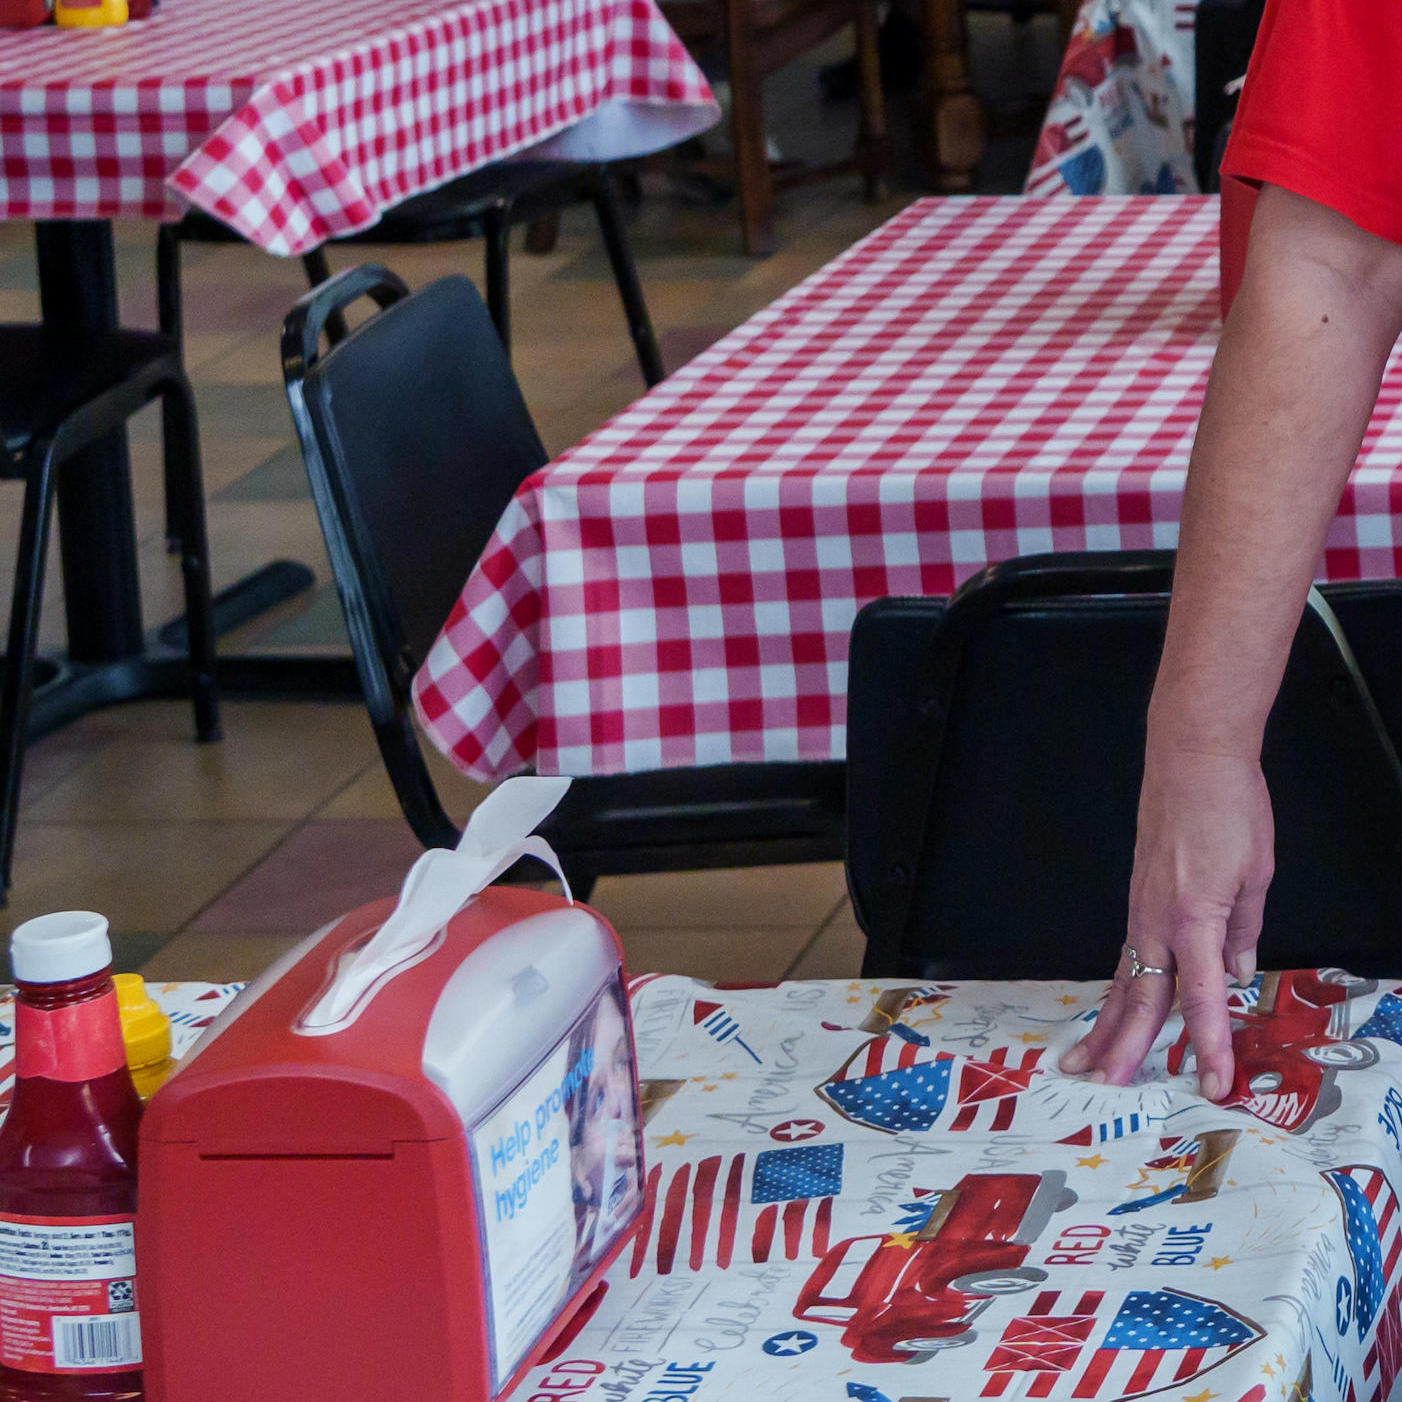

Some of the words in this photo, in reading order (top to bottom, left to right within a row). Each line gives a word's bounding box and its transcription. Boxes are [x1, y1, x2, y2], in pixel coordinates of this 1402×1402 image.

[490, 1120, 532, 1177] Help
[534, 1046, 595, 1141] promote
[495, 1138, 560, 1223] hygiene
[1044, 1224, 1112, 1265] RED
[1106, 1223, 1167, 1272] white
[1151, 1222, 1213, 1266] BLUE
